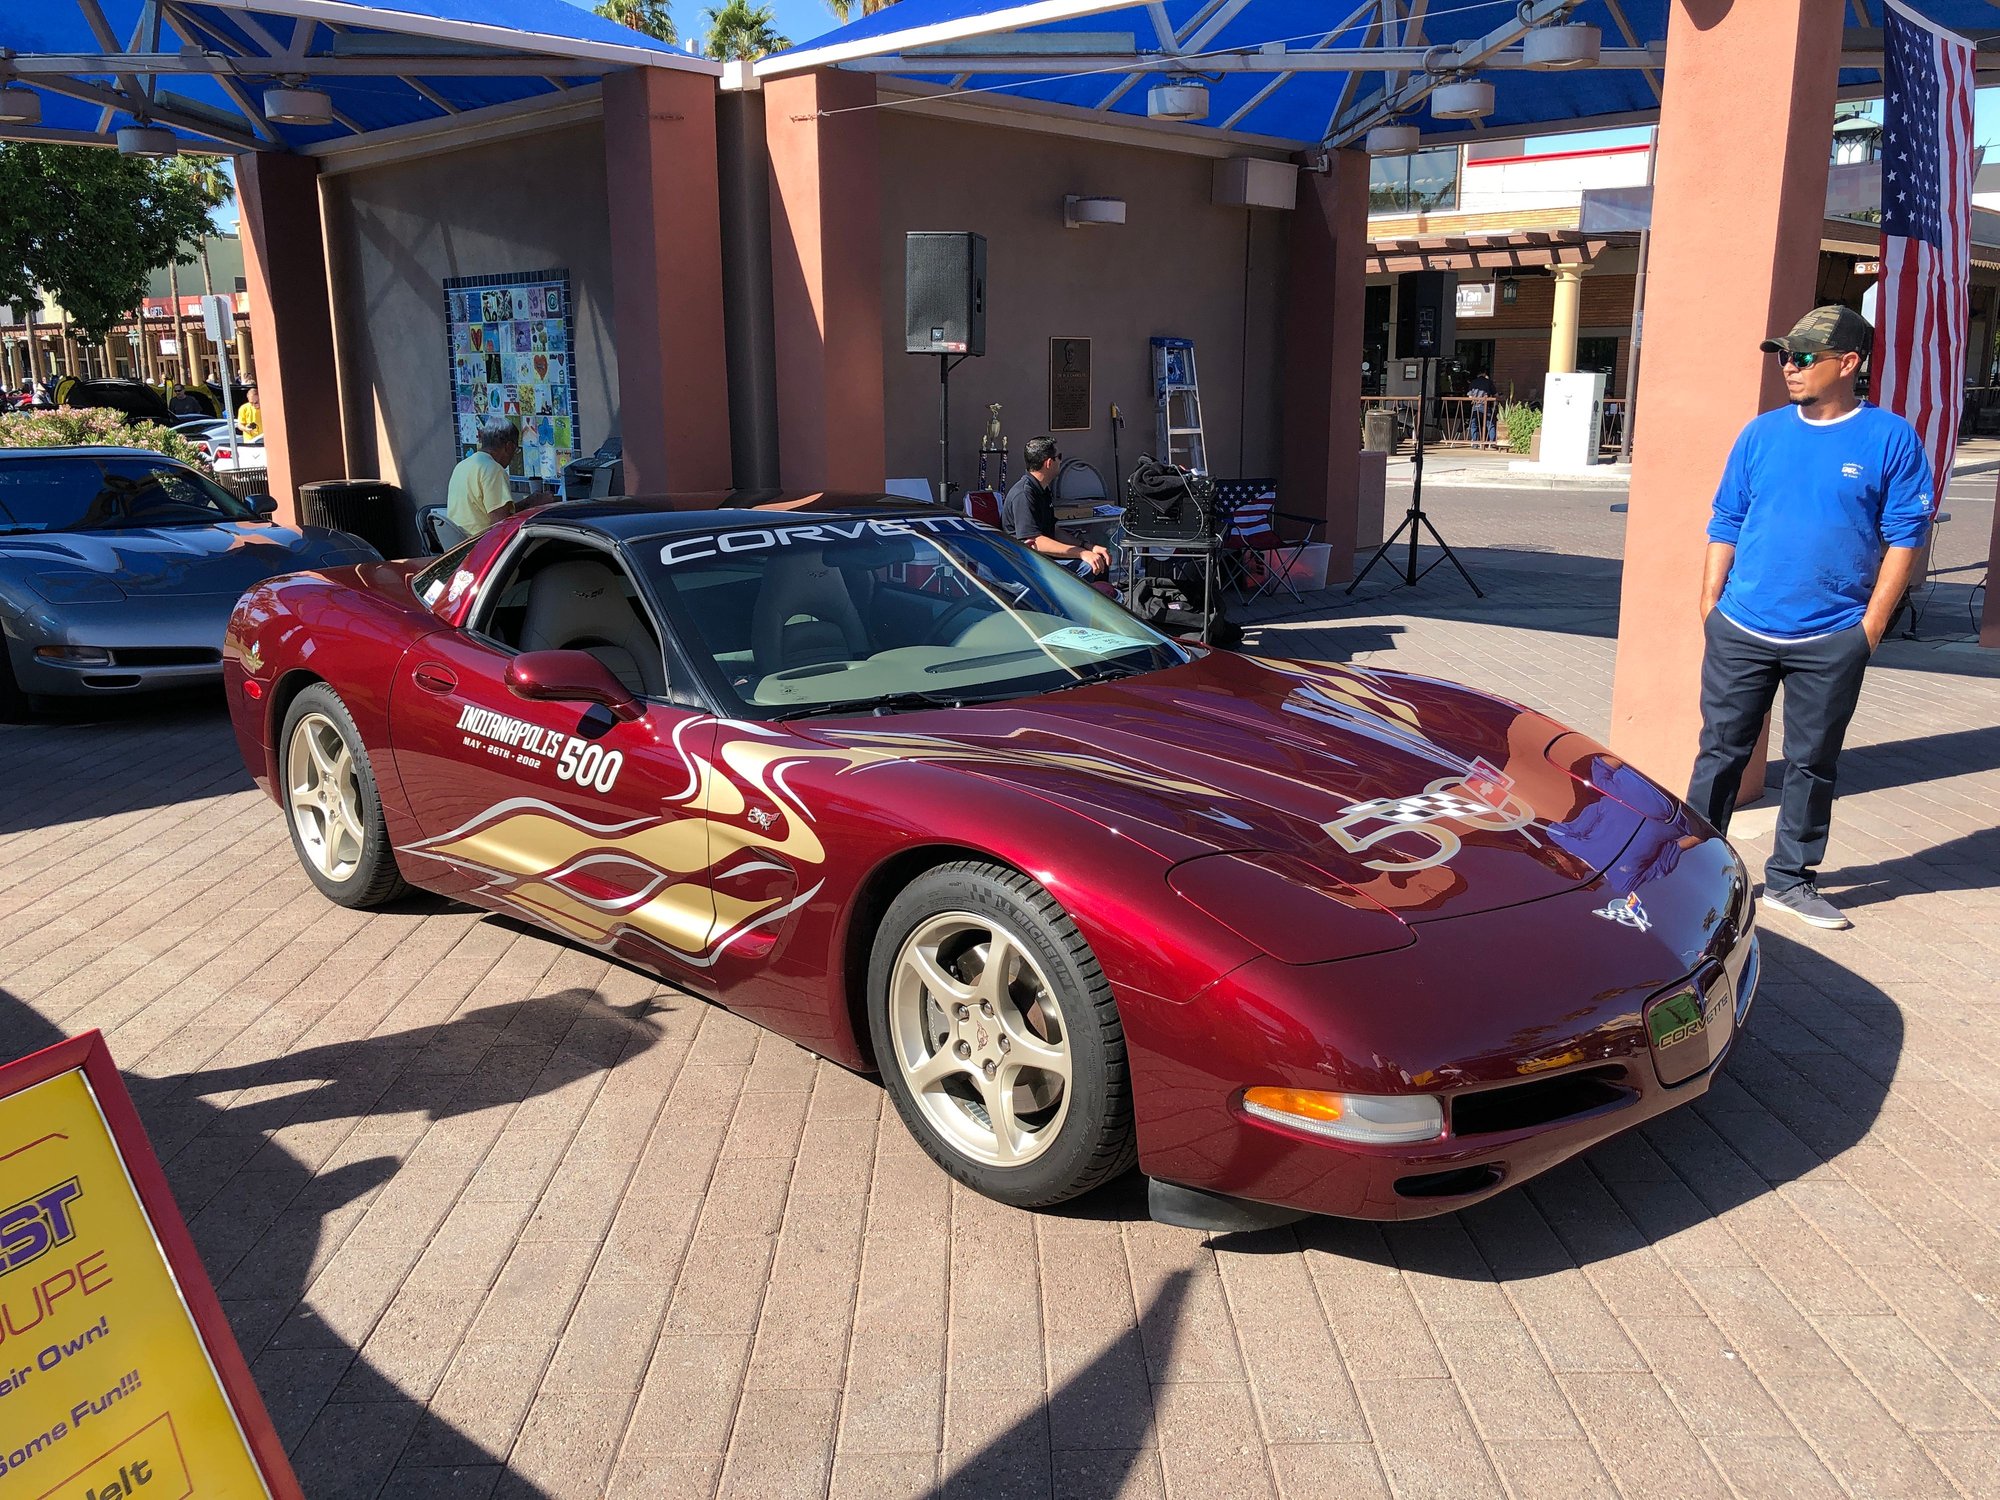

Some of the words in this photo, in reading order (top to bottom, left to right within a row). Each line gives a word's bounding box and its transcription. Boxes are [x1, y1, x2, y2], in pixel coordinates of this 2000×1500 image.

[659, 516, 1001, 566] CORVETTE
[456, 704, 565, 759] INDIANAPOLIS
[556, 736, 624, 794] 500
[462, 736, 482, 750] MAY
[486, 744, 511, 760] 26TH
[516, 753, 541, 769] 2002
[1012, 909, 1074, 993] MICHELIN
[1659, 992, 1729, 1050] CORVETTE
[0, 1175, 84, 1278] ST
[0, 1249, 113, 1345] UPE
[37, 1315, 110, 1372] Own!
[70, 1369, 142, 1429] Fun!!!
